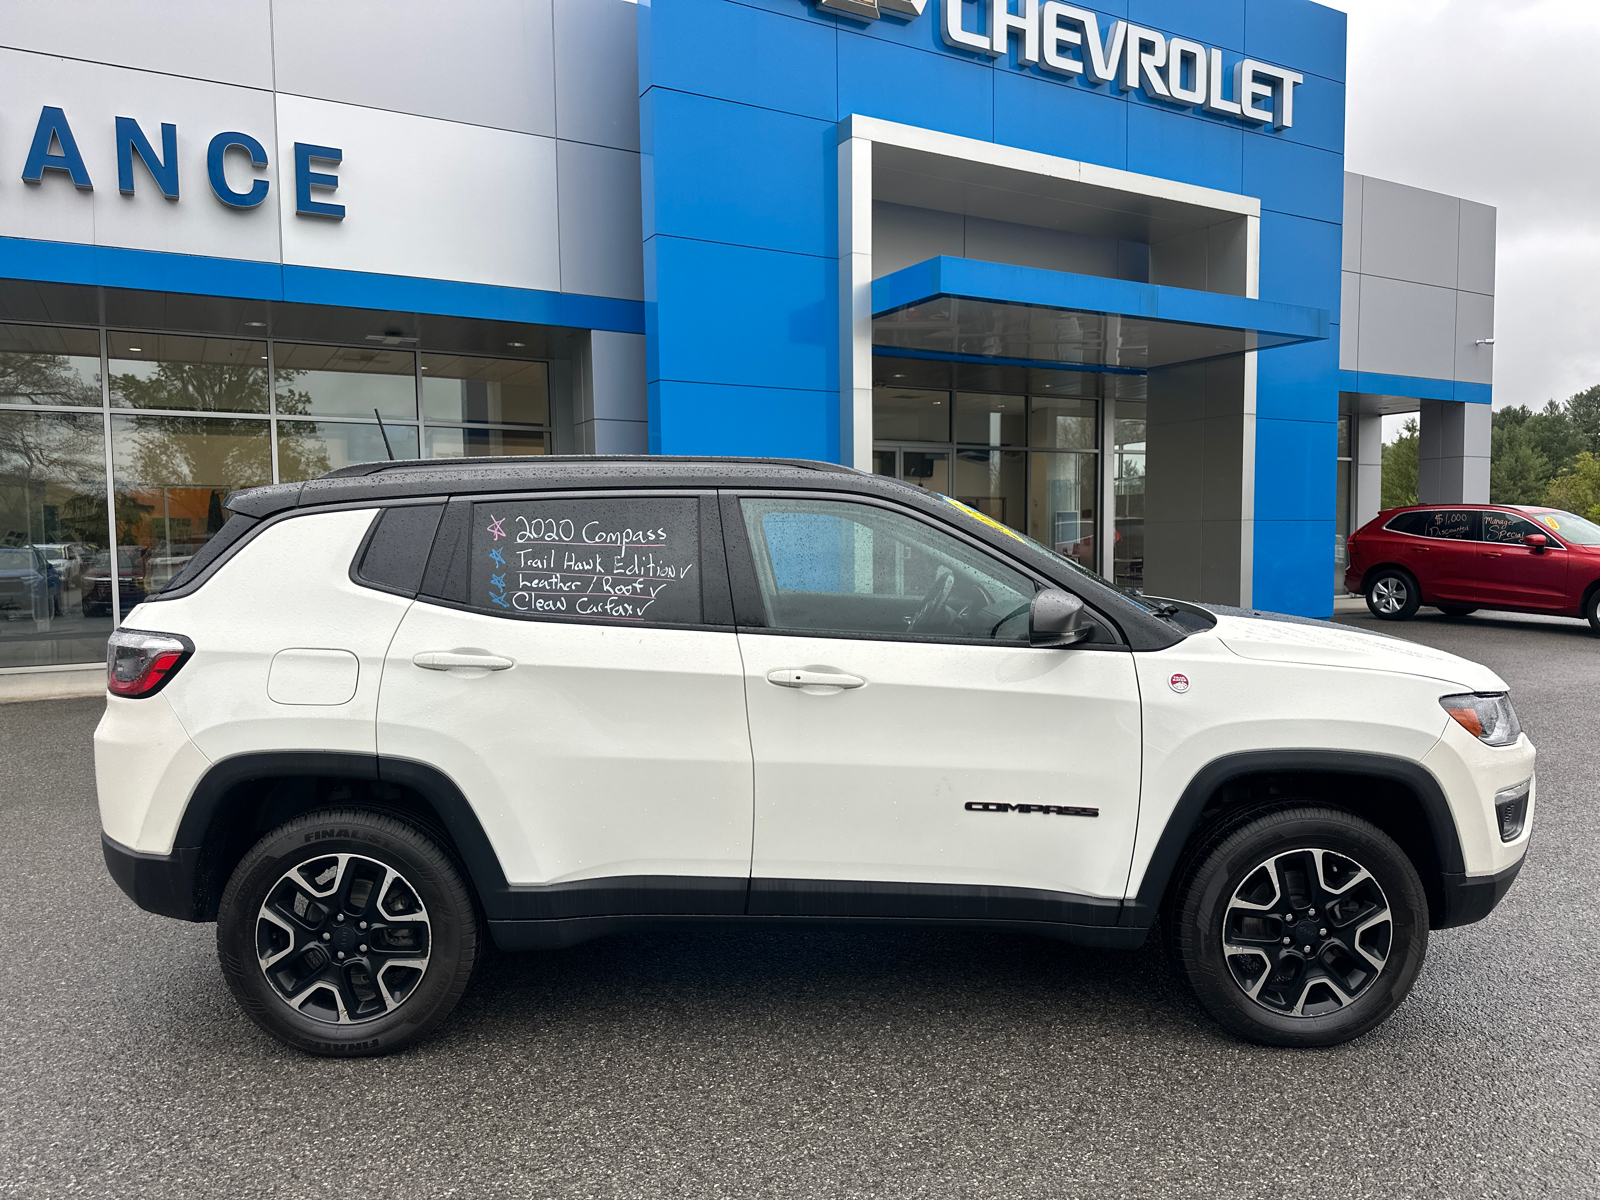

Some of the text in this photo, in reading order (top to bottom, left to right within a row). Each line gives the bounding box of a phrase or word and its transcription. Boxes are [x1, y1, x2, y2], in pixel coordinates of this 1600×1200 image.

[943, 0, 1303, 130] CHEVROLET
[21, 105, 346, 221] ANCE
[1434, 513, 1467, 526] $1,000
[1484, 516, 1516, 530] Manager
[516, 516, 667, 557] 2020 Compass
[1429, 525, 1469, 537] Discounted
[1487, 525, 1525, 541] Special
[516, 549, 676, 577] Trail Hawk Edition
[519, 573, 581, 592] Leather
[602, 575, 644, 595] Roof
[512, 592, 633, 616] Clean Carfax
[964, 801, 1100, 817] COMPASS
[304, 828, 395, 848] FINALIST
